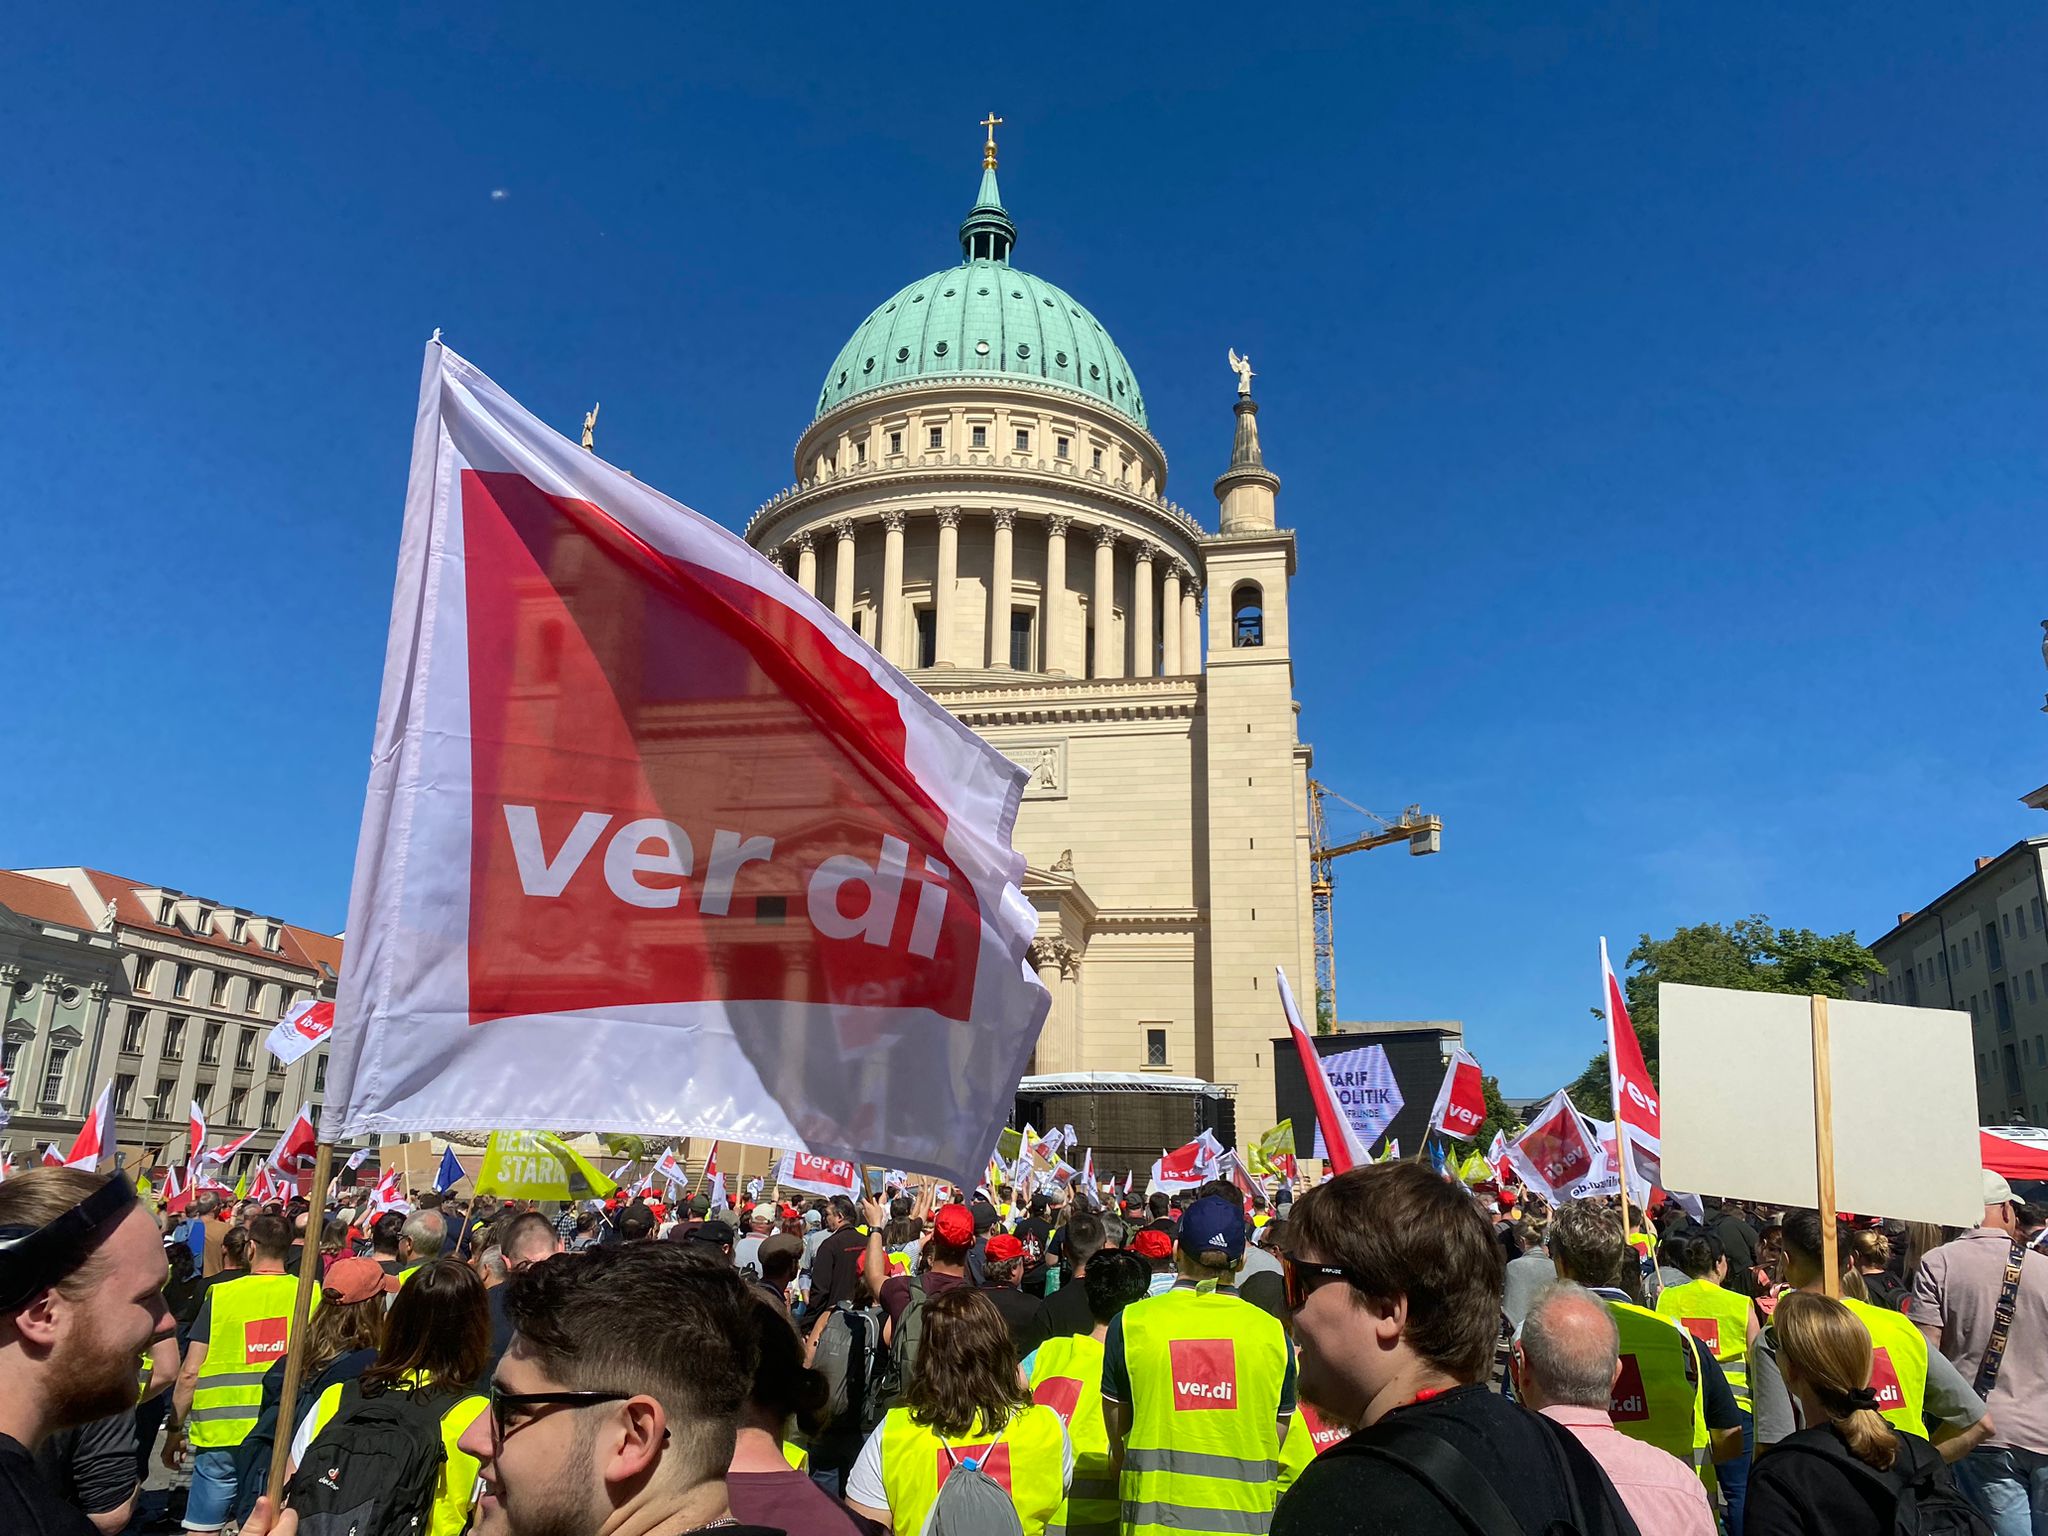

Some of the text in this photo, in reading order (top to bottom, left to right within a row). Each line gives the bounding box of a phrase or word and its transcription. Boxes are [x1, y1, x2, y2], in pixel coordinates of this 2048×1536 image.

[502, 803, 950, 959] ver.di
[1327, 1071, 1368, 1087] TARIF
[800, 1153, 851, 1179] ver.di
[247, 1340, 285, 1353] ver.di
[1177, 1381, 1232, 1400] ver.di
